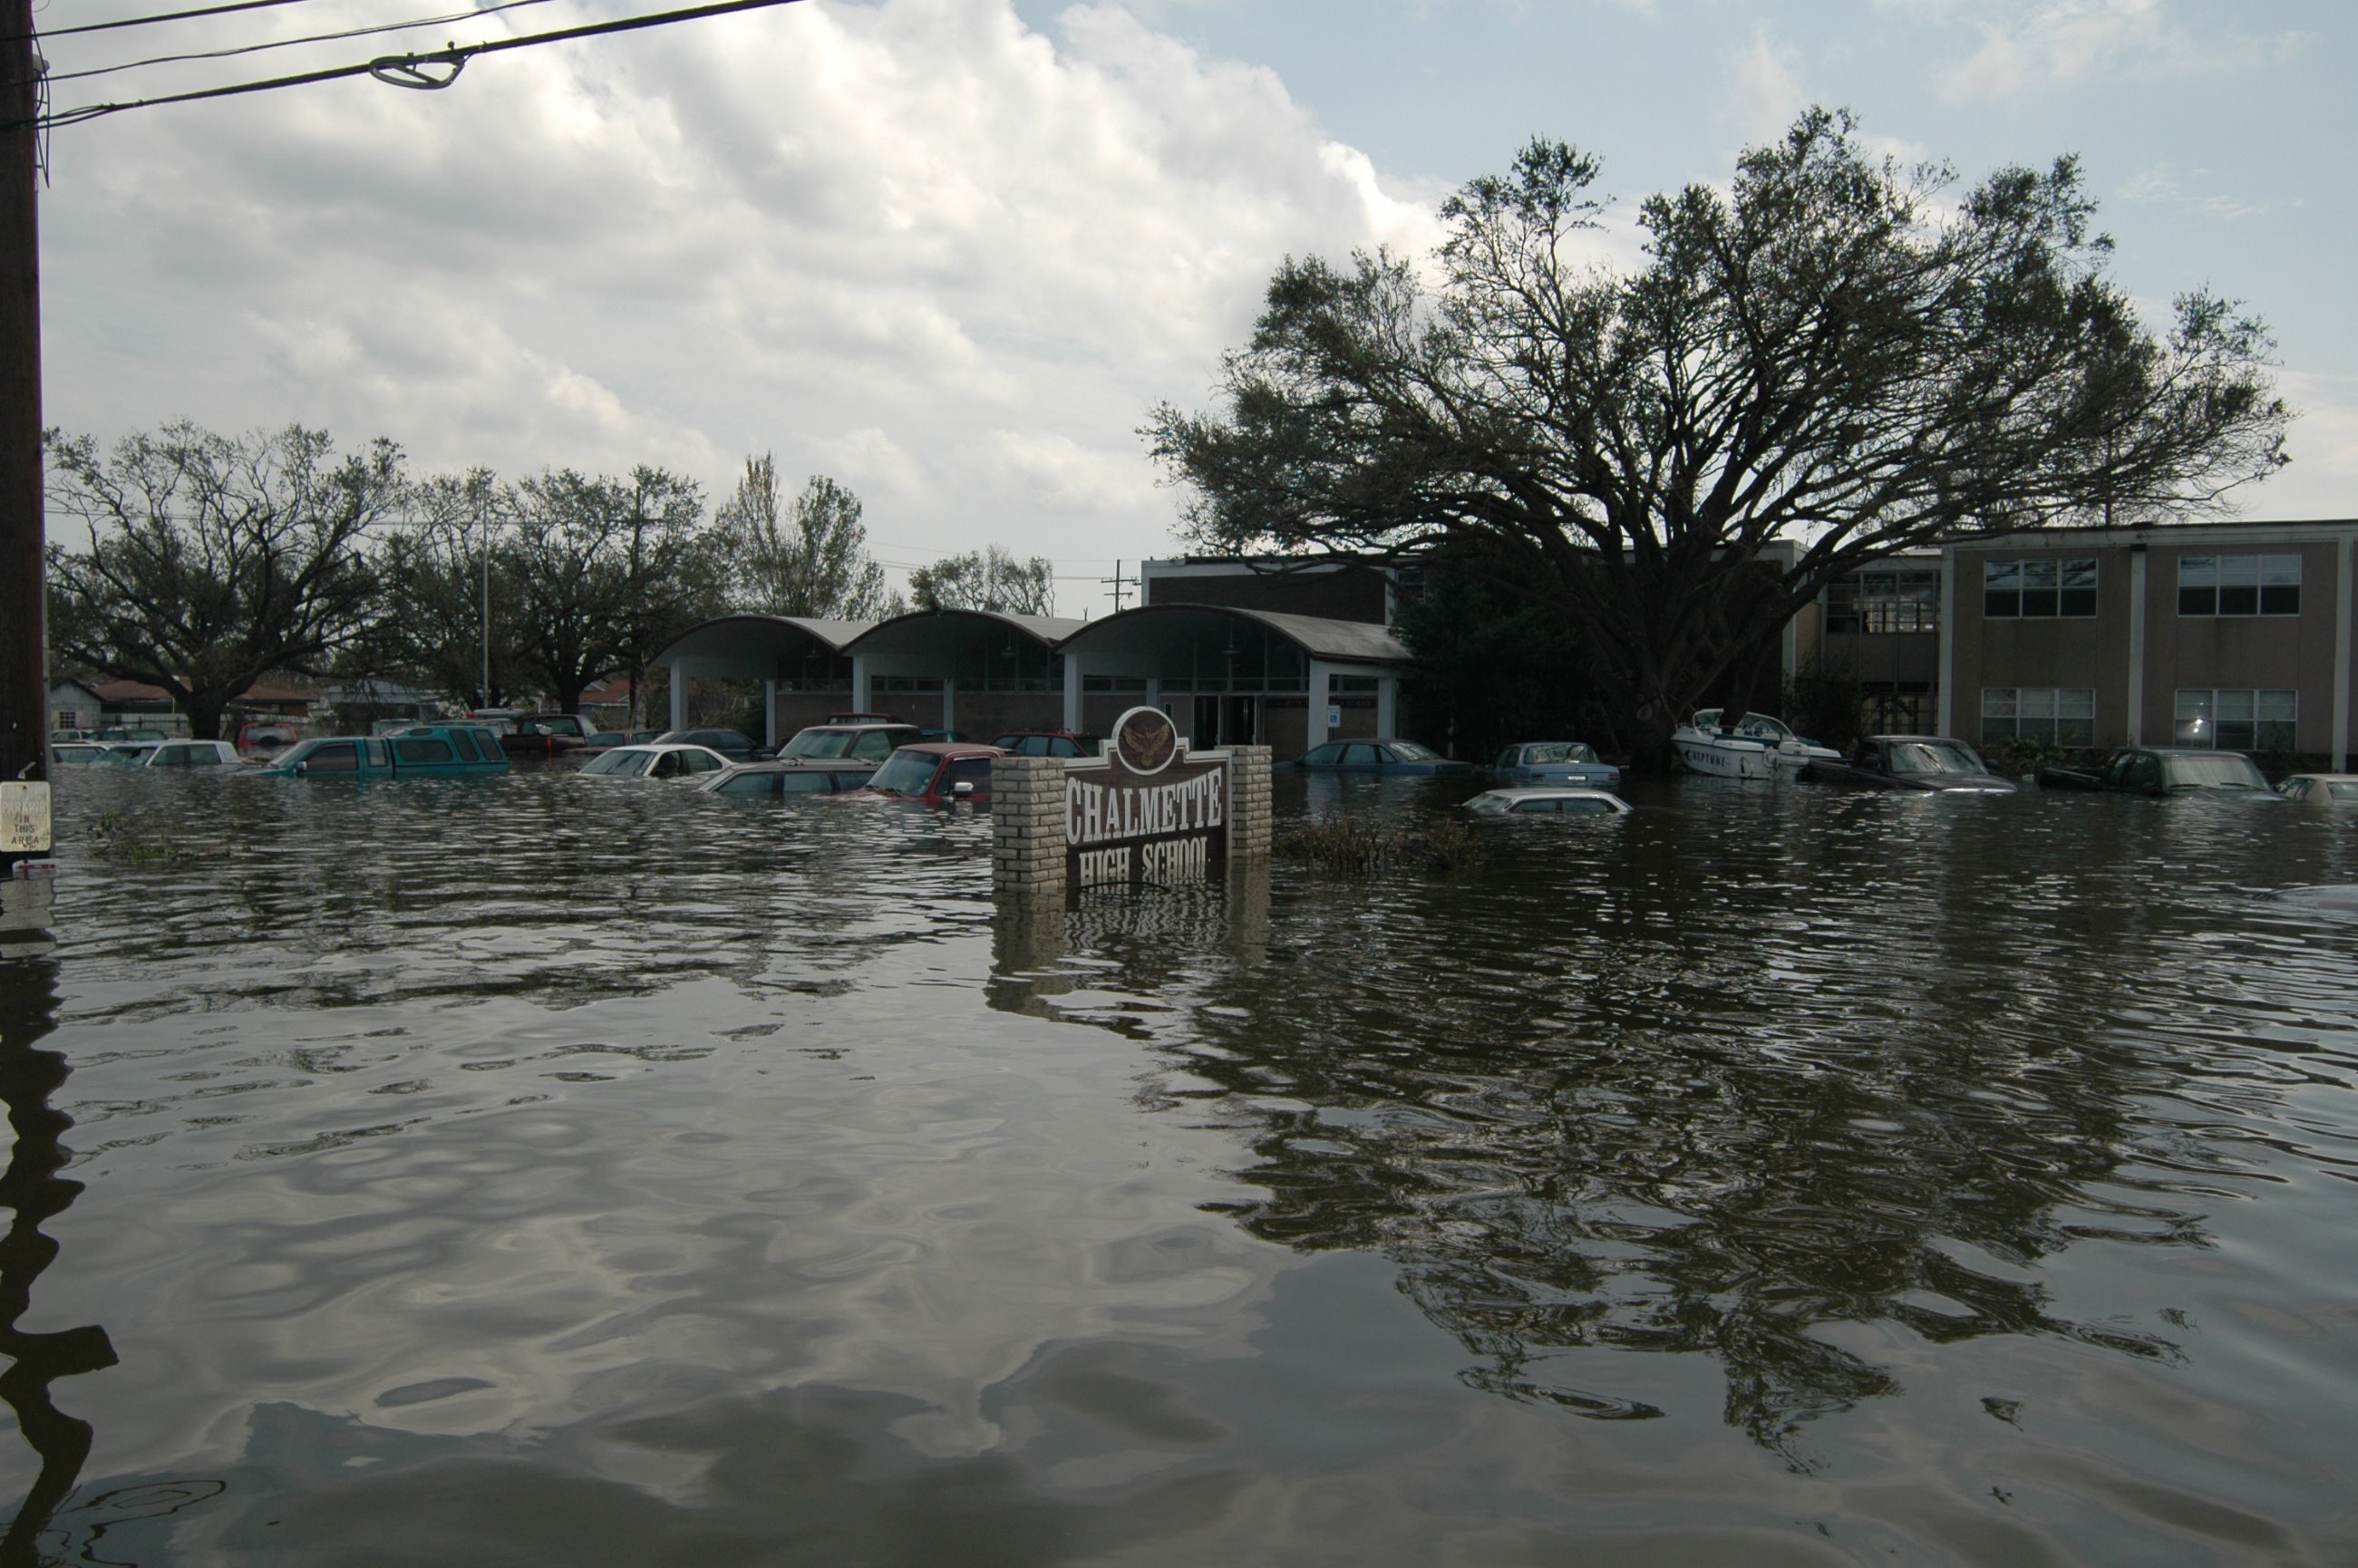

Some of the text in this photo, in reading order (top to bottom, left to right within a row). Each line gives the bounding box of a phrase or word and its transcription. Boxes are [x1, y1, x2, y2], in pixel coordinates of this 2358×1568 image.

[2, 799, 46, 813] PARKING
[1065, 767, 1222, 845] CHALMETTE
[19, 814, 30, 824] IN
[15, 824, 35, 833] THIS
[11, 836, 39, 845] AREA
[1079, 847, 1131, 881] HIGH
